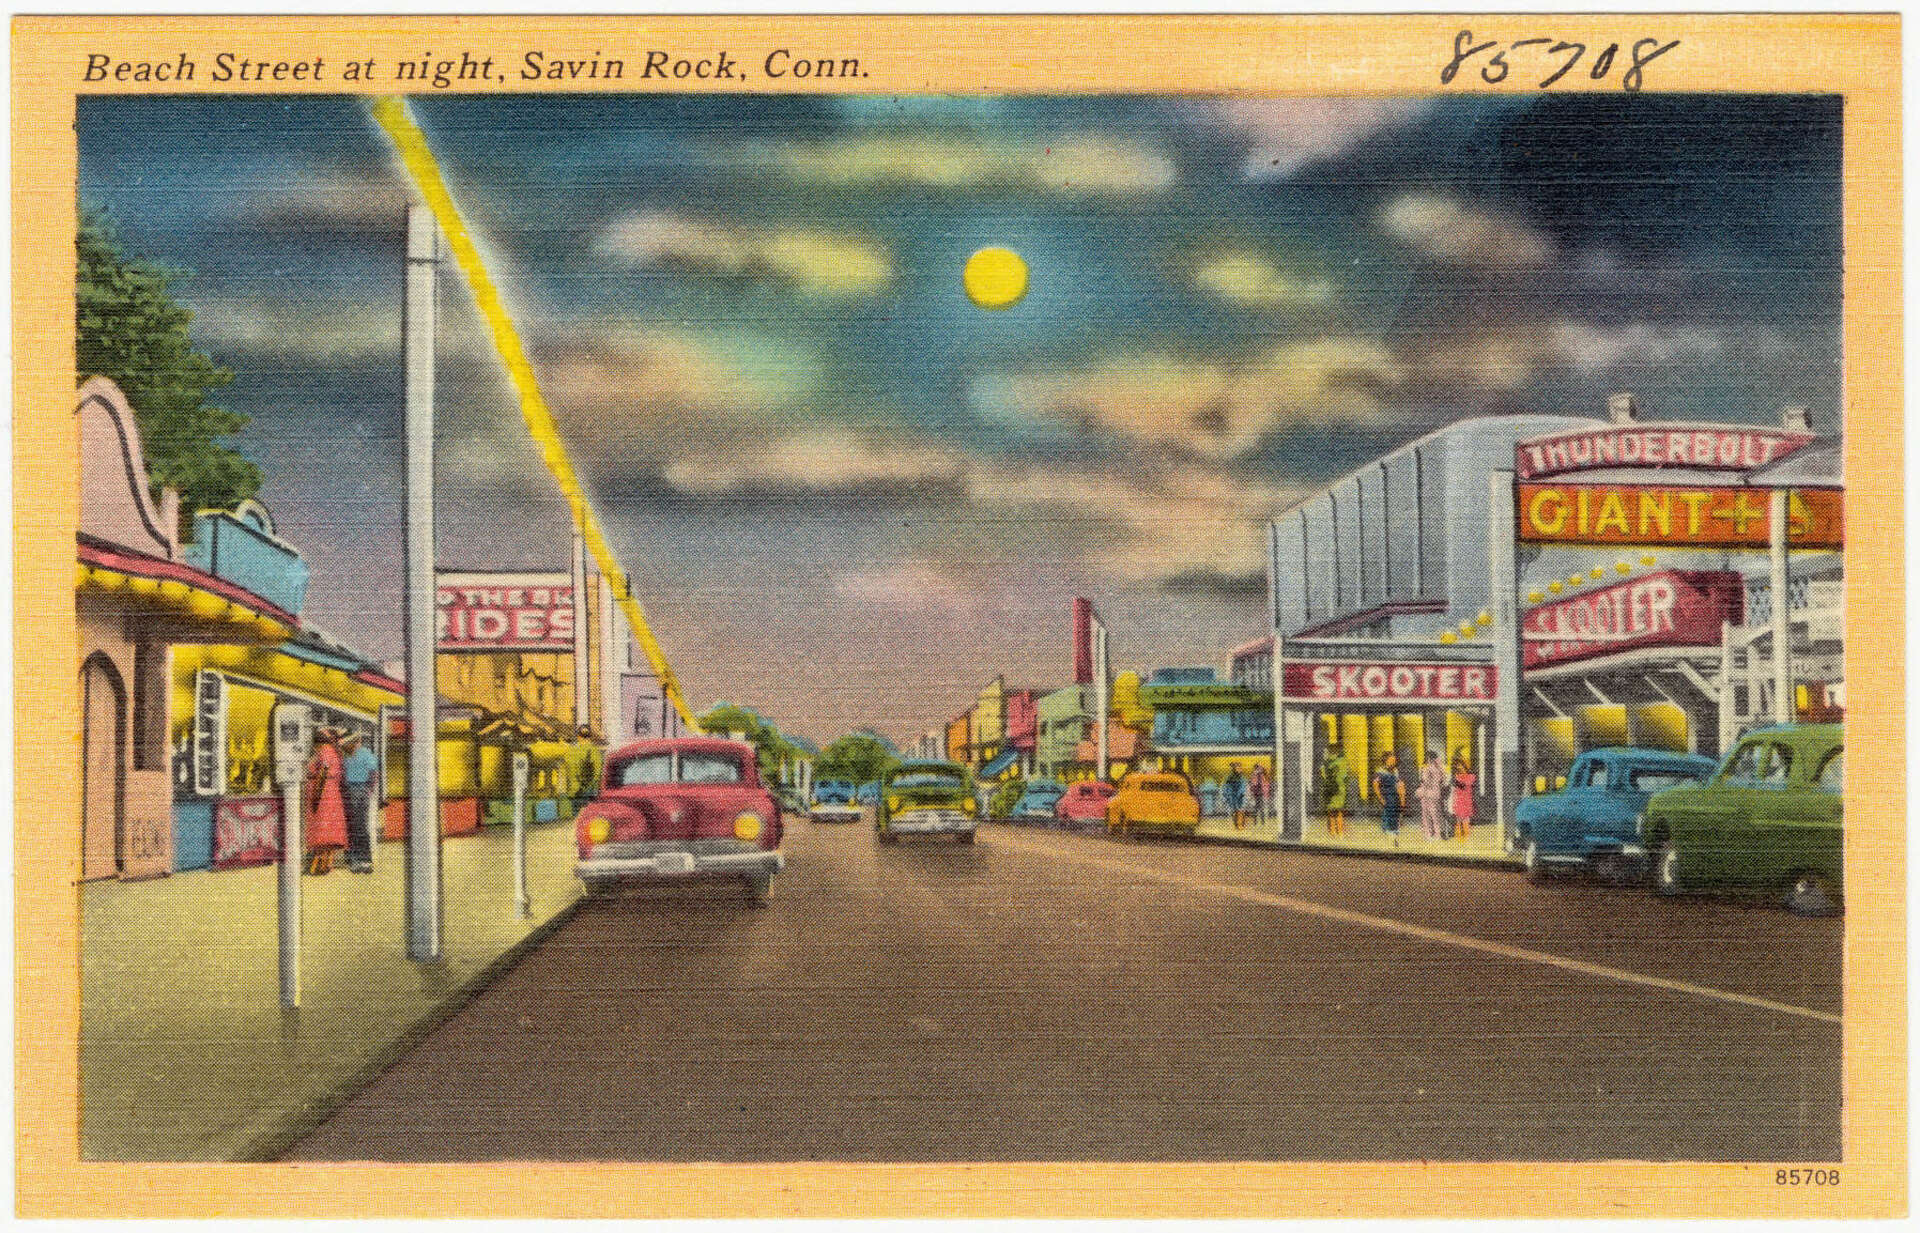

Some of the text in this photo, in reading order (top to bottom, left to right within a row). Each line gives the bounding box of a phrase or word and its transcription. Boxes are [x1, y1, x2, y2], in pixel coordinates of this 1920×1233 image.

[1441, 30, 1680, 92] 85708
[1526, 432, 1784, 471] THUNDERBOLT
[1537, 577, 1677, 657] SKOOTER
[1312, 665, 1488, 699] SKOOTER
